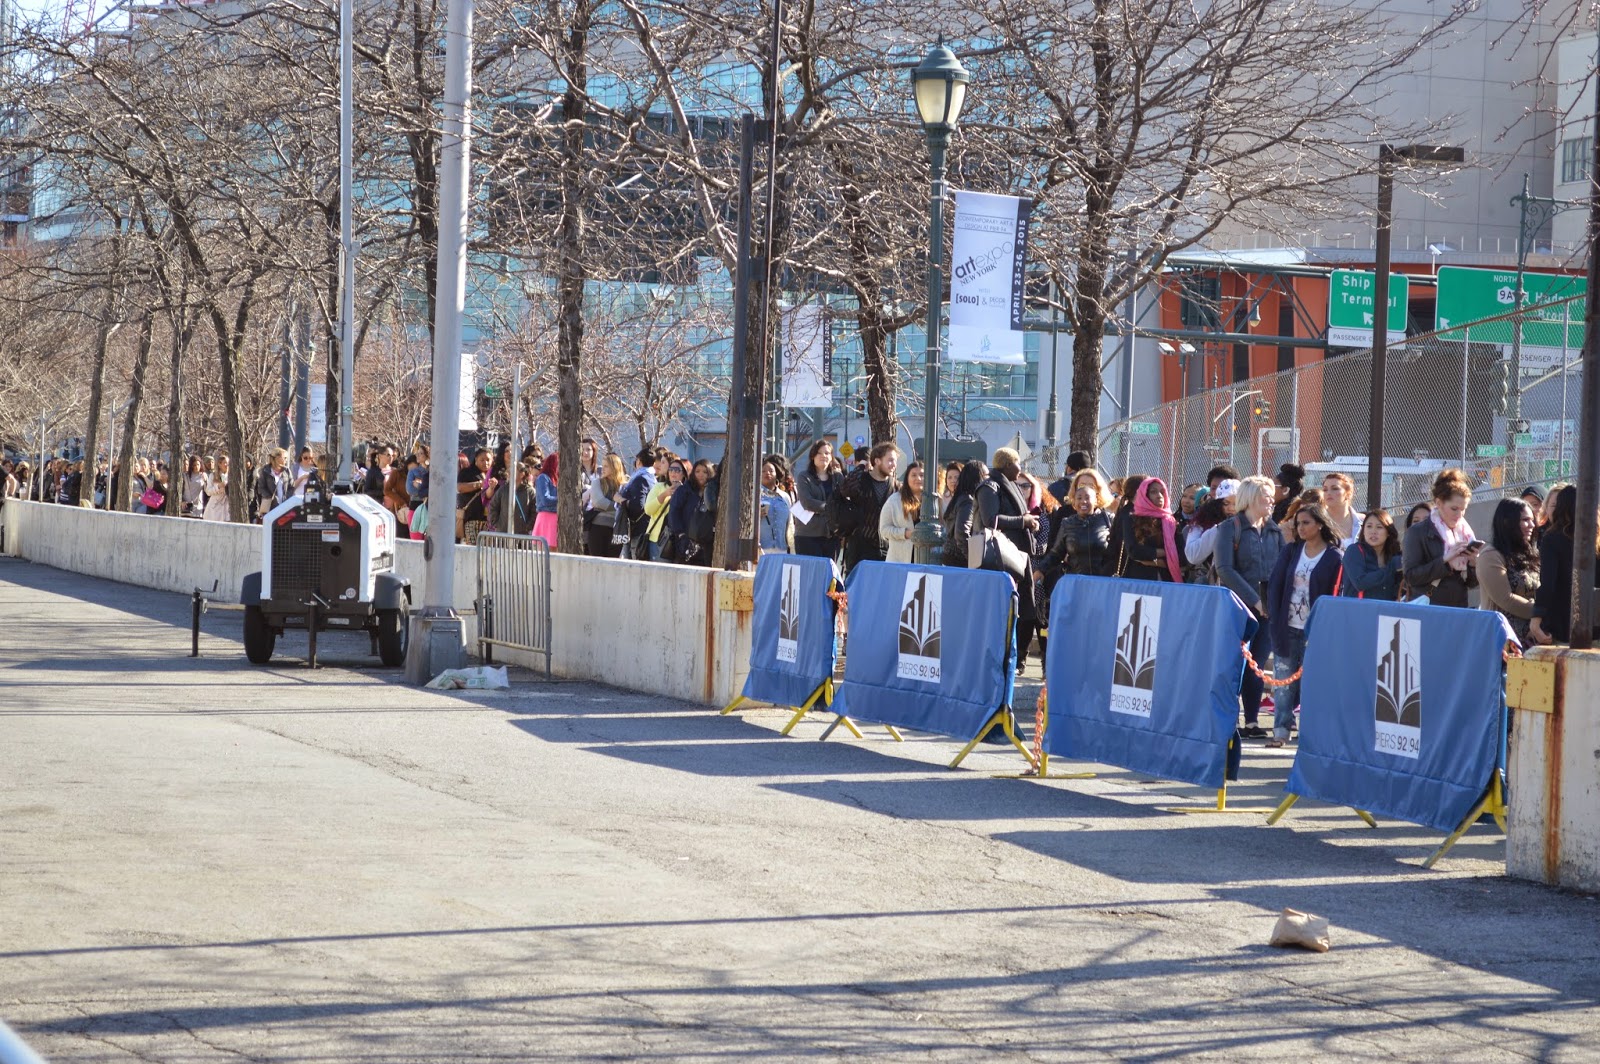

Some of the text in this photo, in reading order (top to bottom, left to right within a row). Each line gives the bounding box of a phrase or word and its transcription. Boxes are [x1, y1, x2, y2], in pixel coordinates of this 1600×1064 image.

[960, 262, 997, 287] NEW YORK
[1013, 219, 1026, 324] APRIL 23-26, 2015
[1493, 275, 1517, 283] NORTH
[1342, 275, 1370, 290] Ship
[1341, 292, 1397, 308] Termal
[1499, 290, 1513, 300] 9A
[1333, 333, 1367, 342] PASSENGER
[898, 661, 940, 679] PIERS 92 94
[1111, 693, 1131, 710] PIERS
[1131, 697, 1142, 711] 92
[1397, 735, 1408, 751] 92
[1409, 737, 1420, 754] 94
